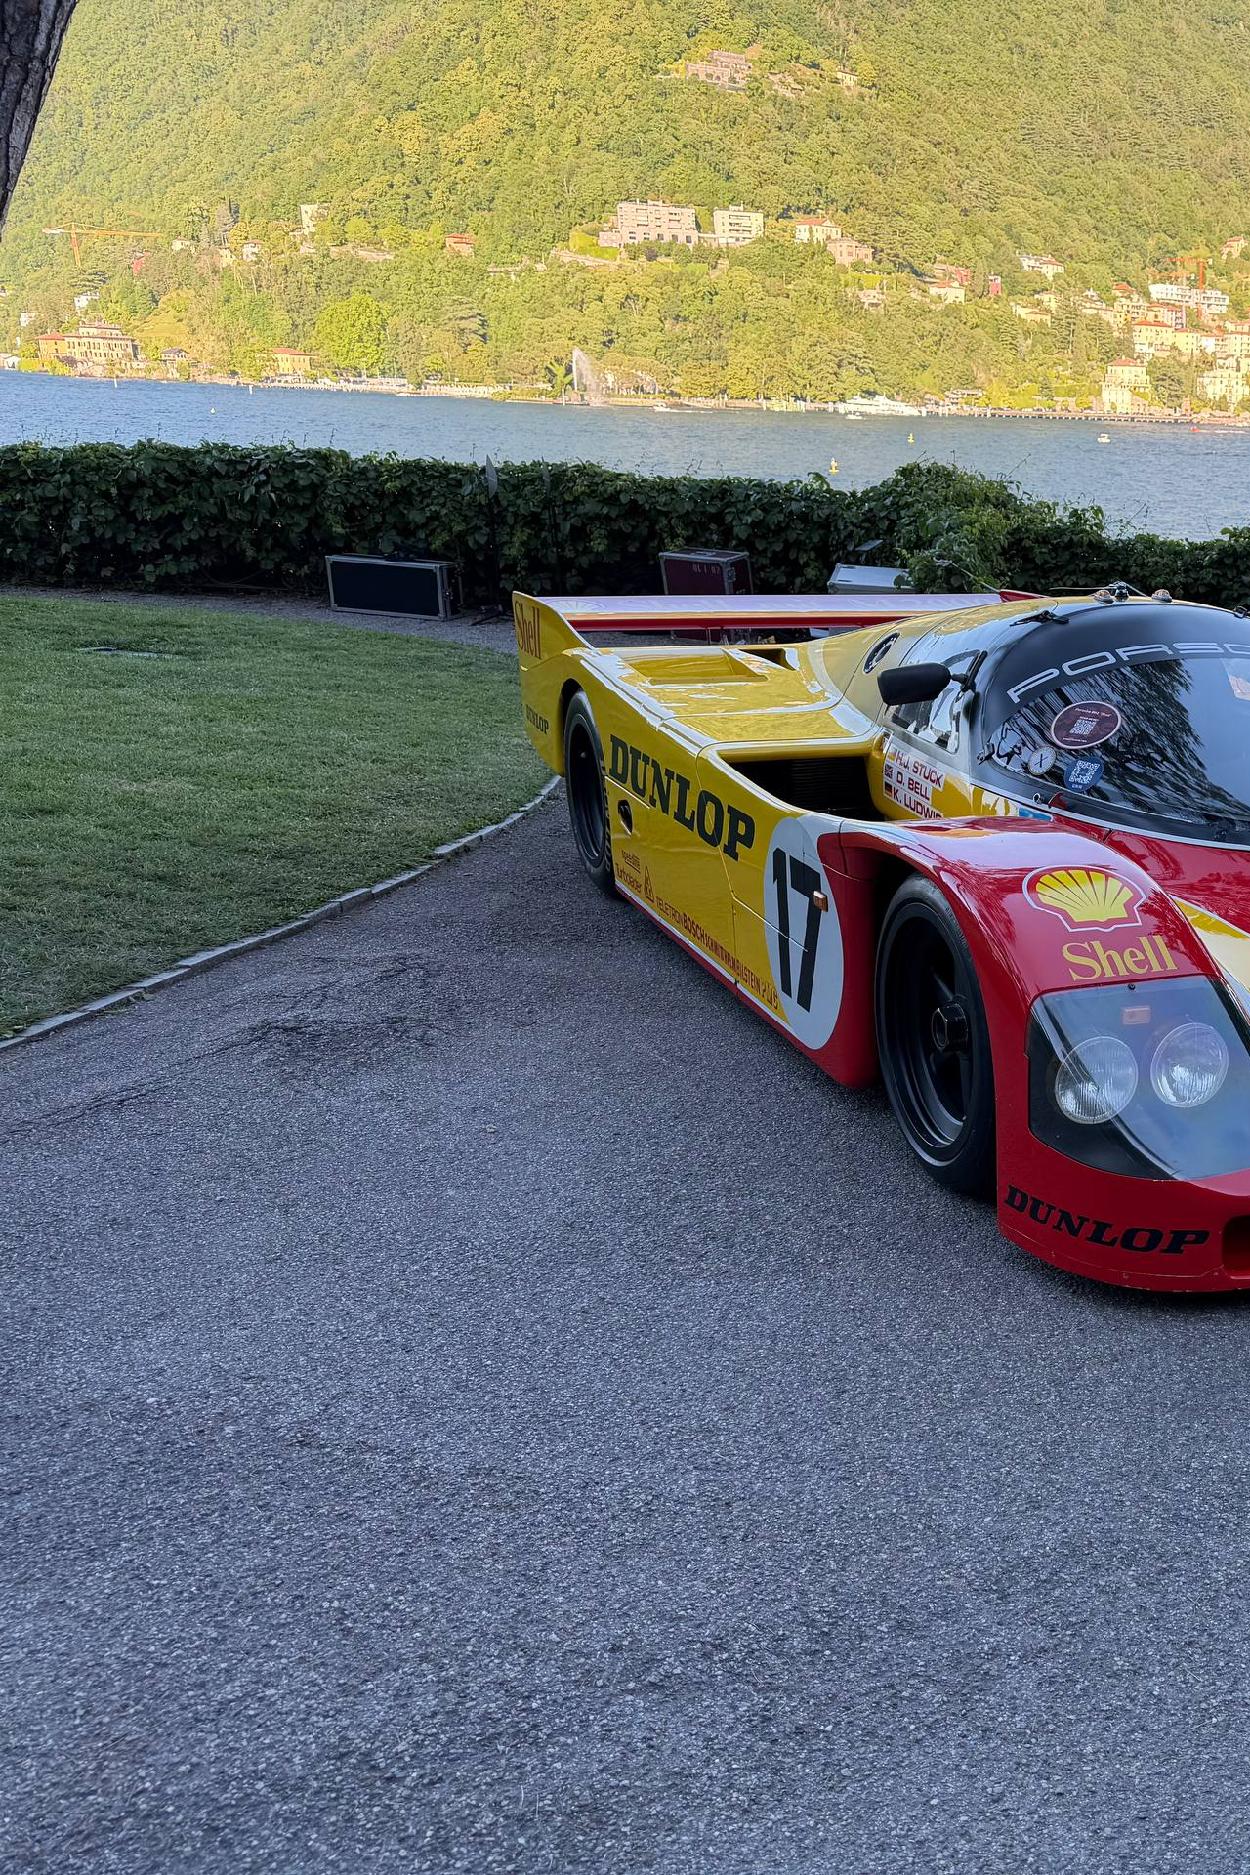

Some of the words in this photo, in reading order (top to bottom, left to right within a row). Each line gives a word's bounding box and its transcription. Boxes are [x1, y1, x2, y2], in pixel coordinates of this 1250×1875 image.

[514, 600, 542, 660] Shell
[609, 734, 756, 860] DUNLOP
[893, 787, 902, 803] K.
[896, 771, 905, 786] D.
[908, 777, 930, 801] BELL
[912, 761, 943, 788] STUCK
[683, 912, 705, 945] BOSCH
[773, 847, 823, 1013] 17
[1061, 934, 1178, 981] Shell
[1002, 1184, 1210, 1255] DUNLOP
